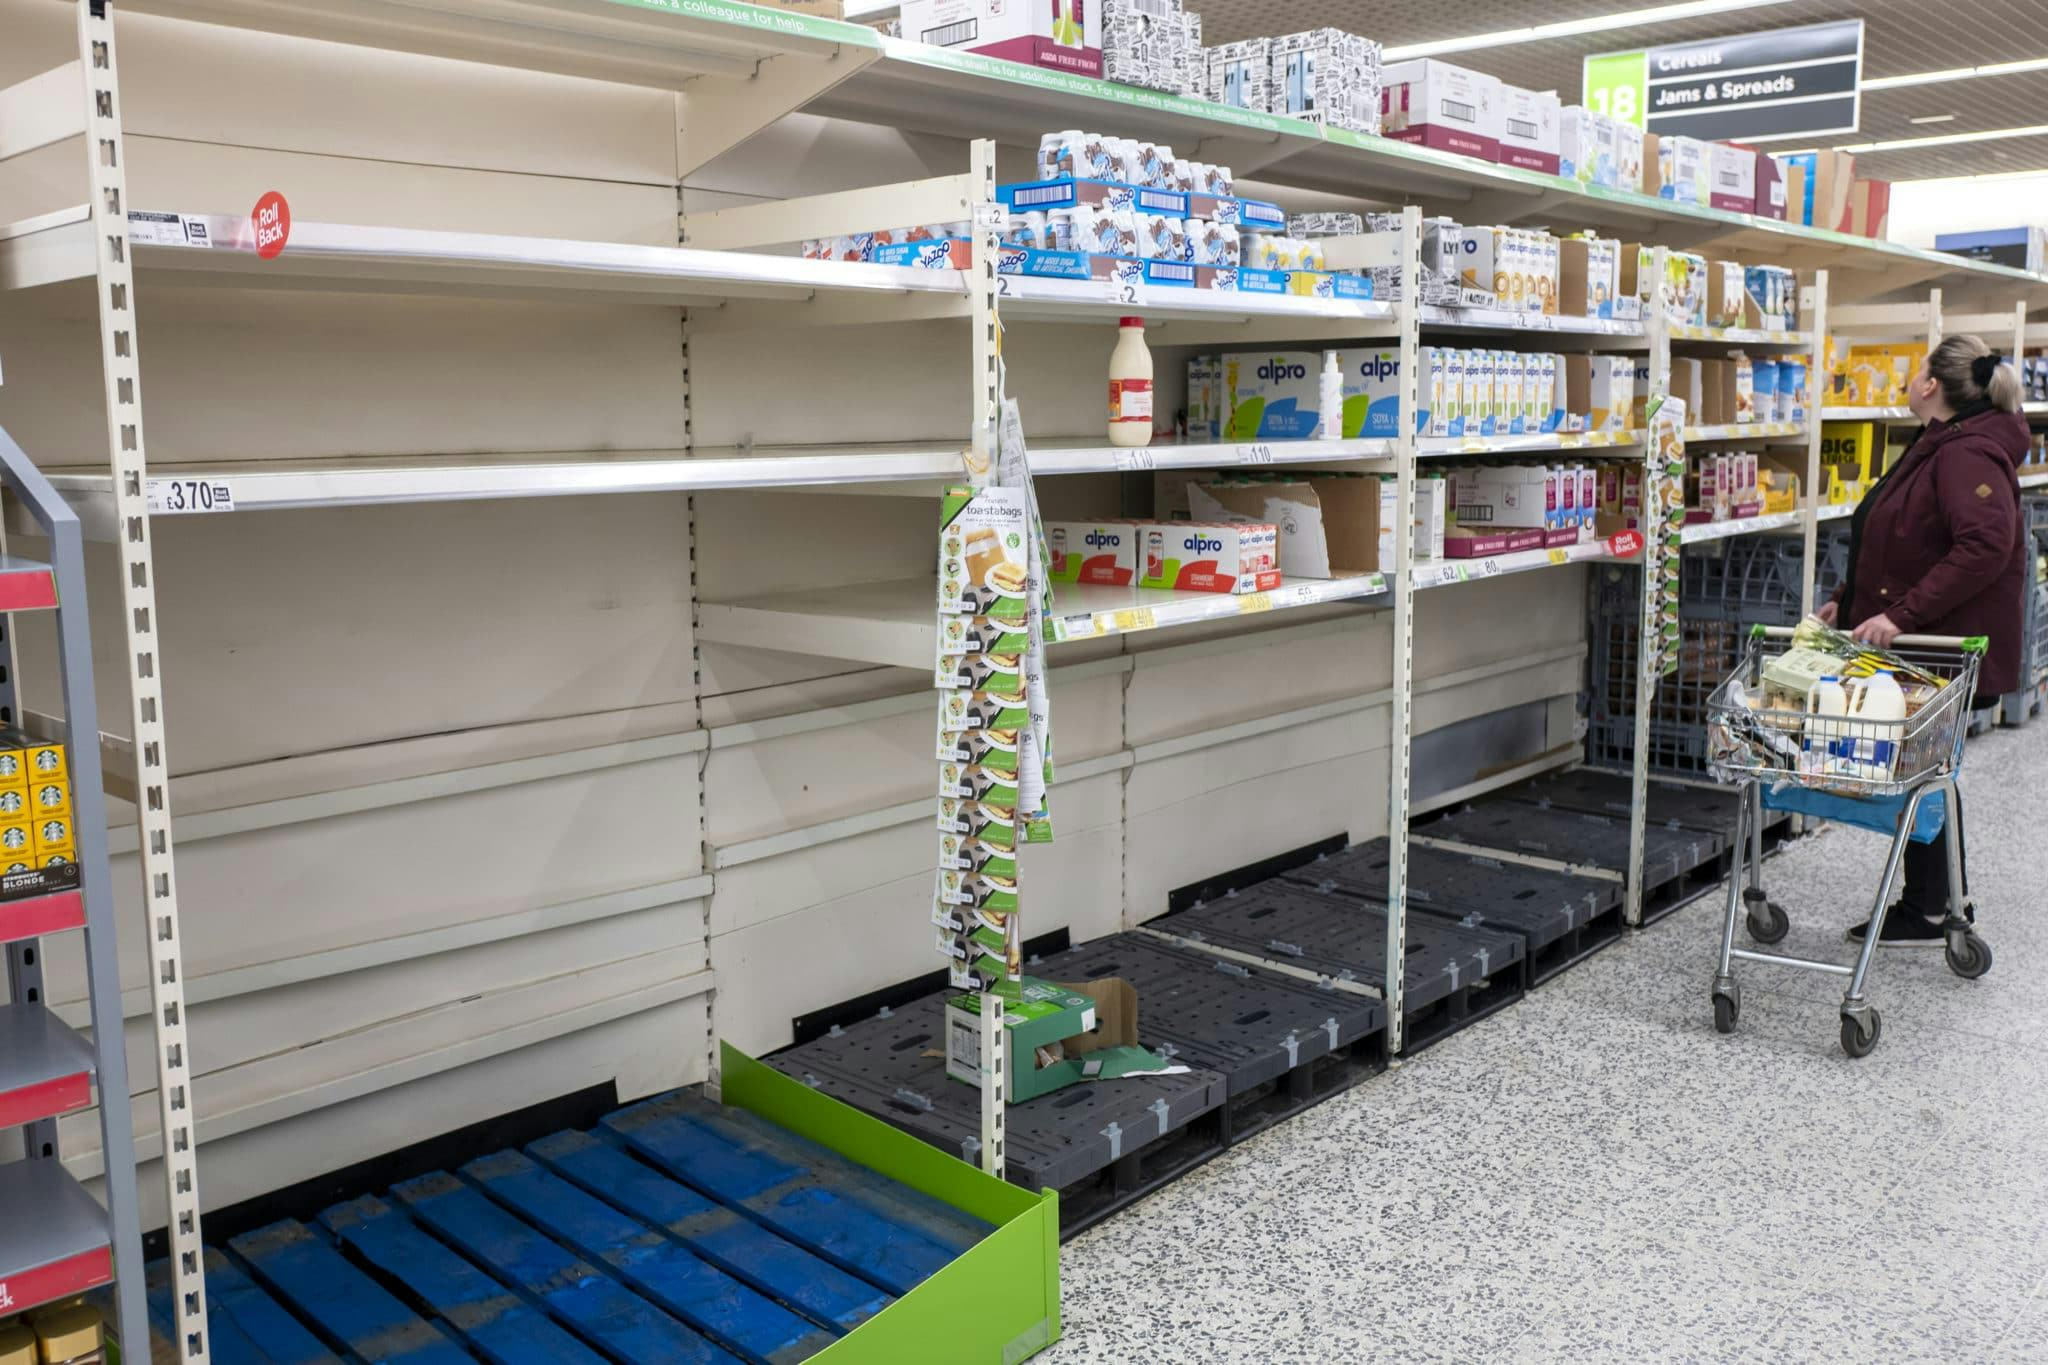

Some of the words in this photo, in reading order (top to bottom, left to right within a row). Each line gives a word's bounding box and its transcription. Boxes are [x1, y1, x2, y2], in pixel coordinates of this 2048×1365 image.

[683, 1, 750, 21] colleague
[752, 11, 772, 25] for
[776, 15, 809, 32] help.
[1040, 52, 1058, 62] ASDA
[1658, 51, 1722, 71] Cereals
[1656, 89, 1701, 106] Jams
[1703, 84, 1718, 100] &
[1721, 75, 1795, 100] Spreads
[1593, 84, 1637, 121] 18
[1109, 189, 1134, 206] YAZOO
[259, 201, 279, 228] Roll
[258, 222, 284, 247] Back
[920, 241, 950, 268] YAZOO
[998, 252, 1027, 267] AZOO
[1118, 261, 1144, 281] YAZOO
[1217, 270, 1238, 288] YAZOO
[1119, 286, 1138, 304] £2
[1257, 359, 1306, 385] alpro
[1360, 354, 1400, 382] alpr
[1820, 439, 1855, 454] BIG
[167, 481, 213, 510] £3.70
[966, 506, 1023, 518] toastabags
[1086, 529, 1121, 550] alpro
[1184, 534, 1223, 555] alpro
[1615, 533, 1632, 546] Roll
[1616, 540, 1637, 554] Back
[3, 875, 45, 889] BLONDE
